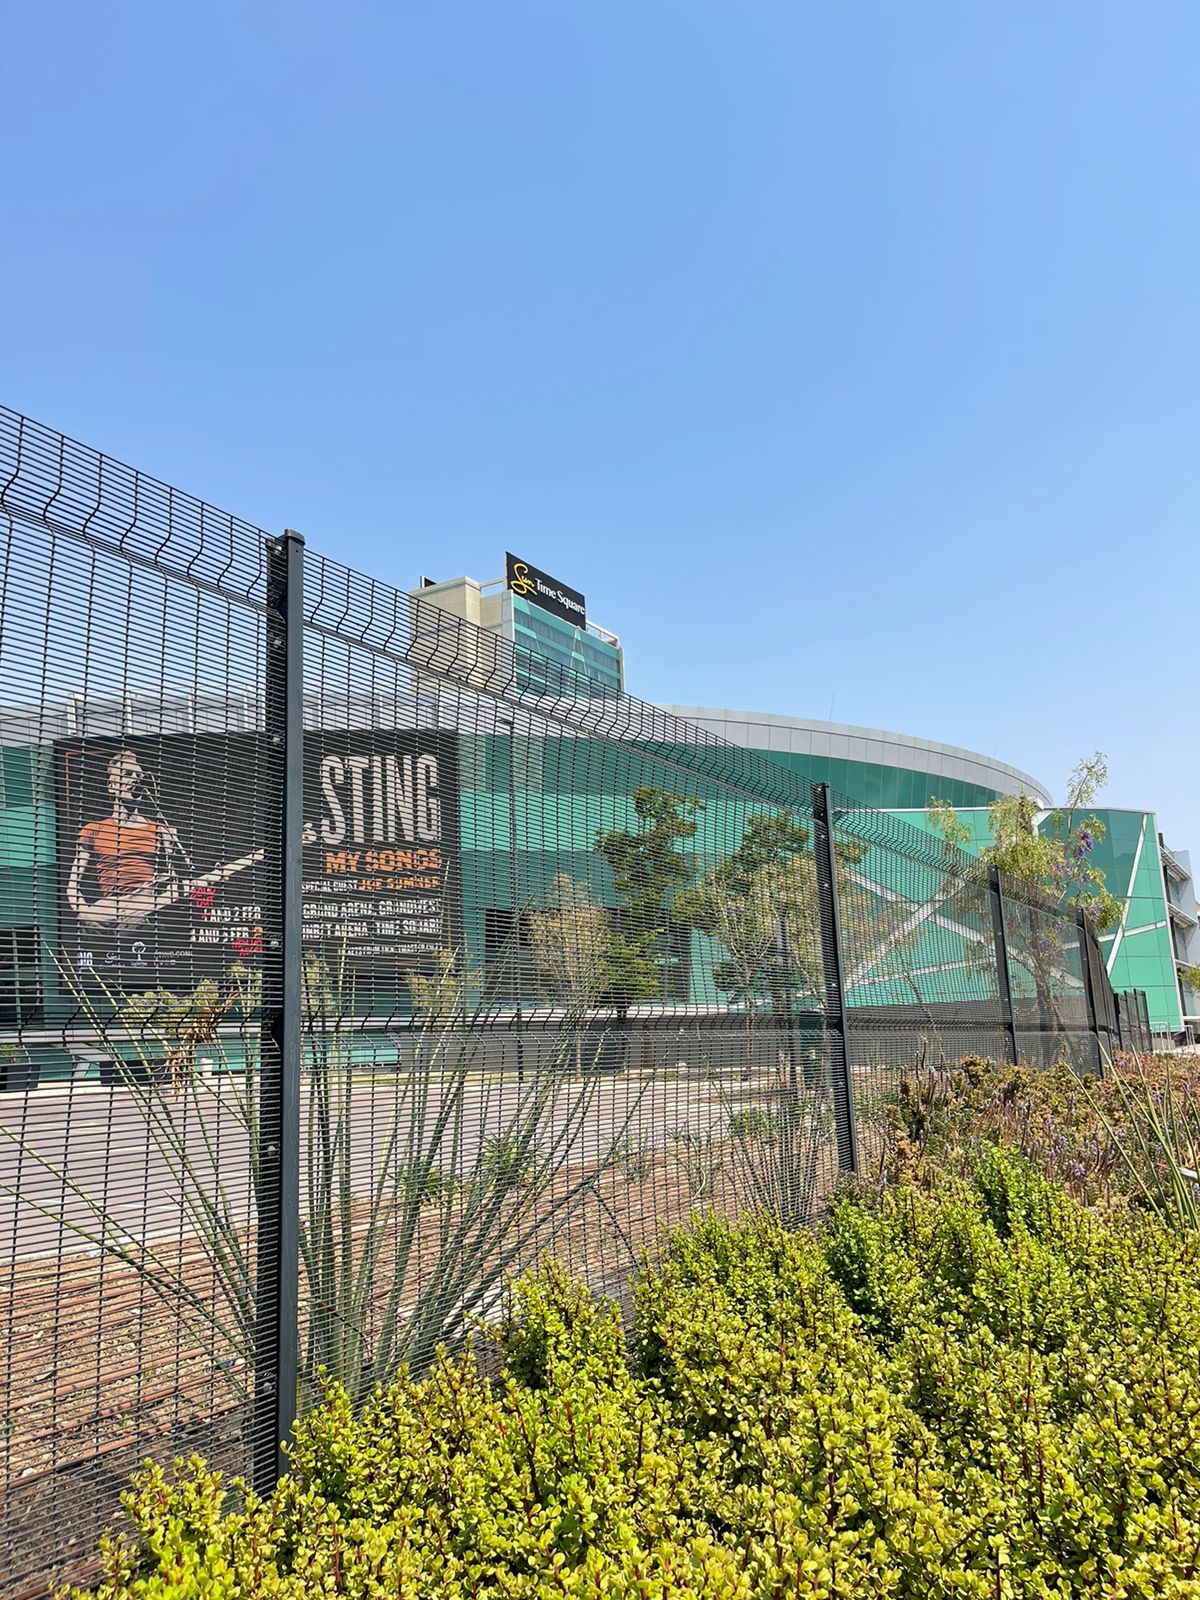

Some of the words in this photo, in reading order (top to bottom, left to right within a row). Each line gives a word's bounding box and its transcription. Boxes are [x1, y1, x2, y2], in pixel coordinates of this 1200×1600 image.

[510, 563, 538, 596] Sun
[535, 577, 557, 599] Time
[557, 590, 585, 615] Square
[320, 754, 440, 845] STING
[325, 851, 361, 875] MY
[365, 848, 442, 872] SONGS
